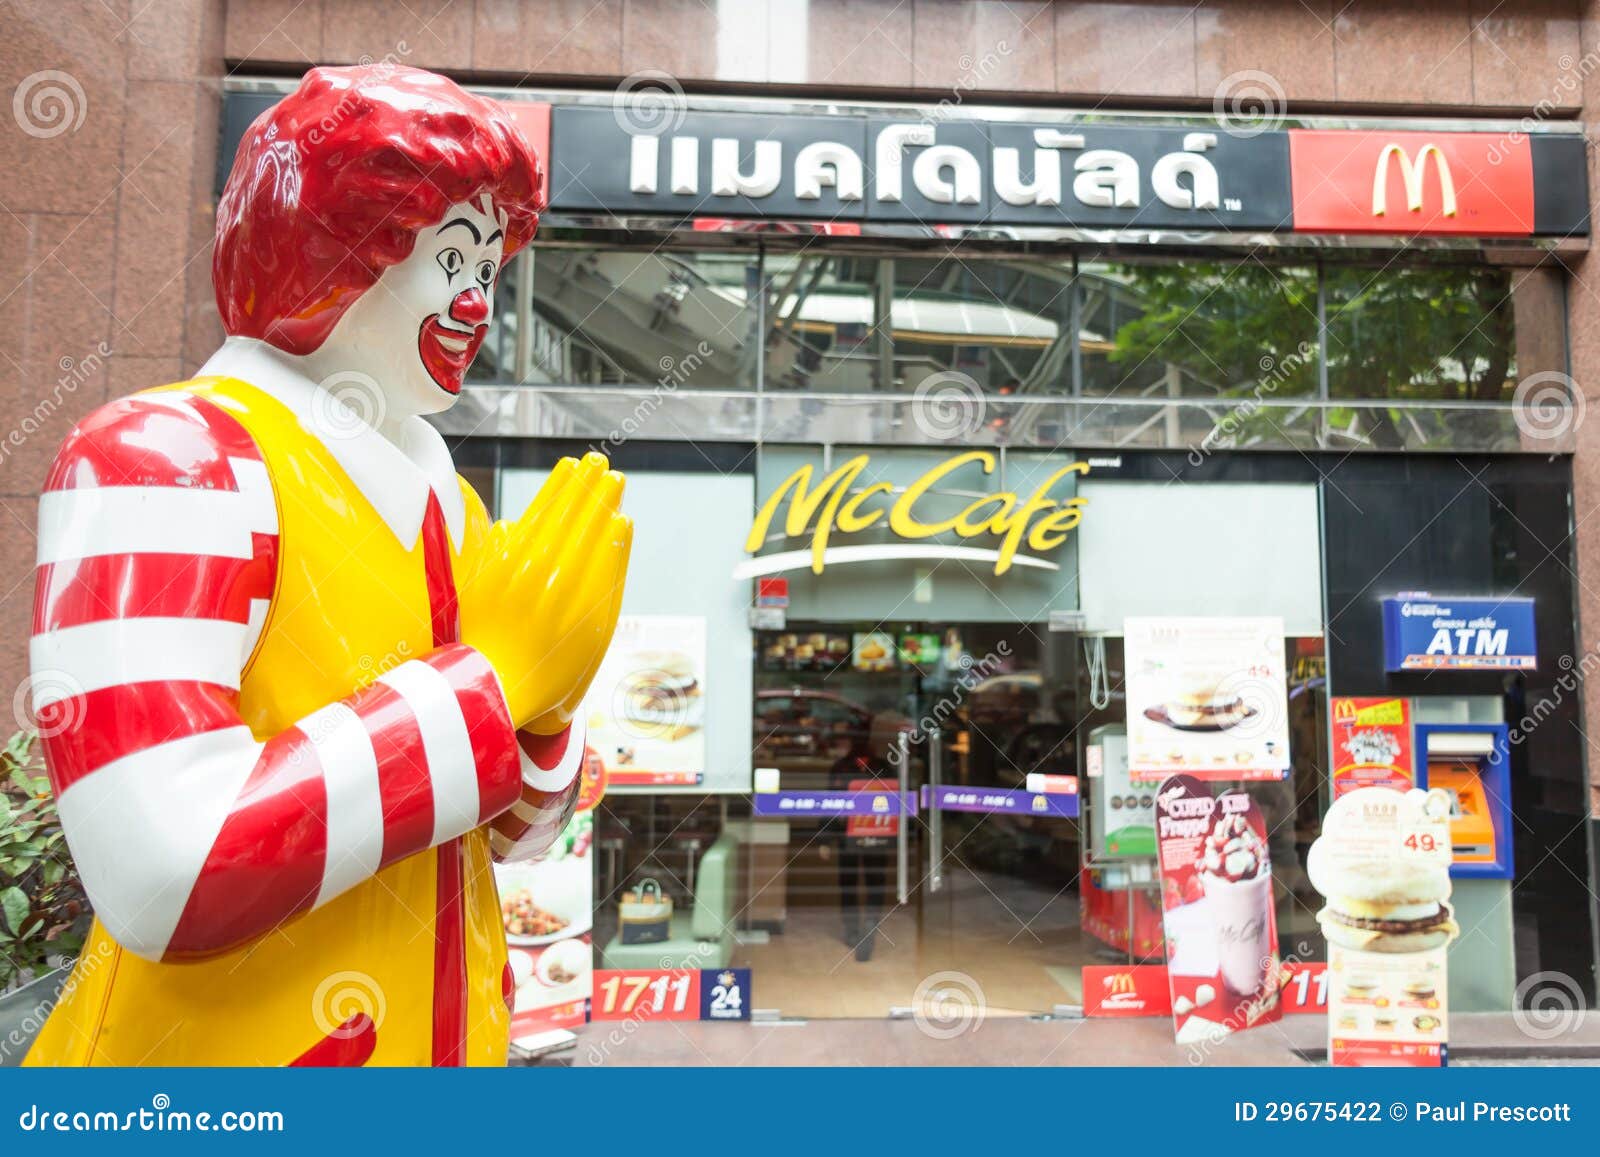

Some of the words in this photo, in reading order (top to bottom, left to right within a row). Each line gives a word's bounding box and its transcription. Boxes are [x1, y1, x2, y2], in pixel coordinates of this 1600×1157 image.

[744, 451, 1091, 575] McCafé
[1425, 628, 1509, 655] ATM
[600, 975, 691, 1014] 1711
[710, 985, 742, 1008] 24
[1292, 970, 1328, 1006] 11
